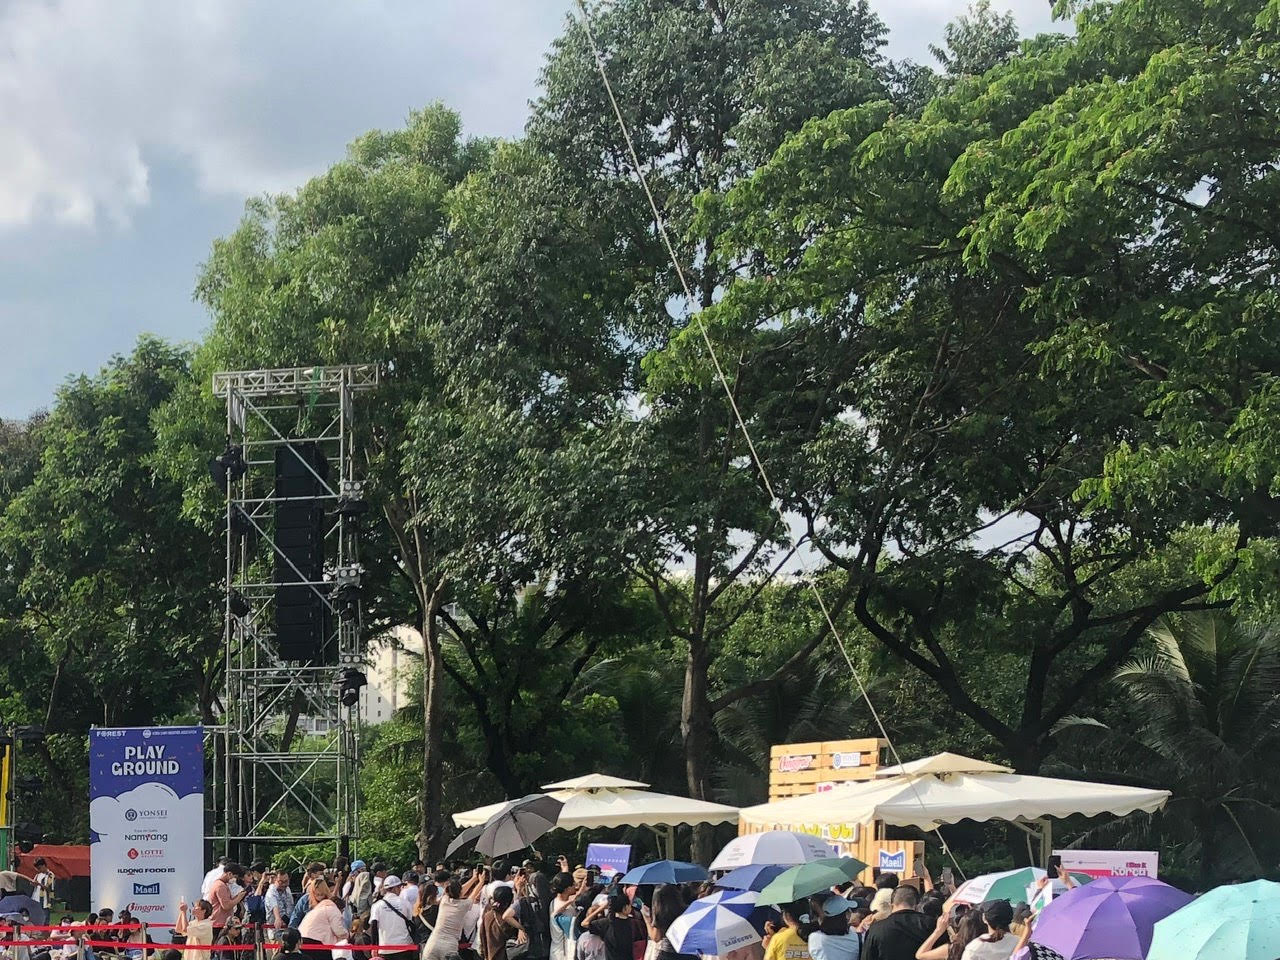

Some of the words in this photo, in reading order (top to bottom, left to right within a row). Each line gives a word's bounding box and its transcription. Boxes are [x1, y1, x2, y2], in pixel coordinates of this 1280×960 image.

[124, 745, 166, 760] PLAY
[111, 760, 180, 776] GROUND
[881, 856, 903, 867] Maeil
[135, 885, 158, 894] Maeil
